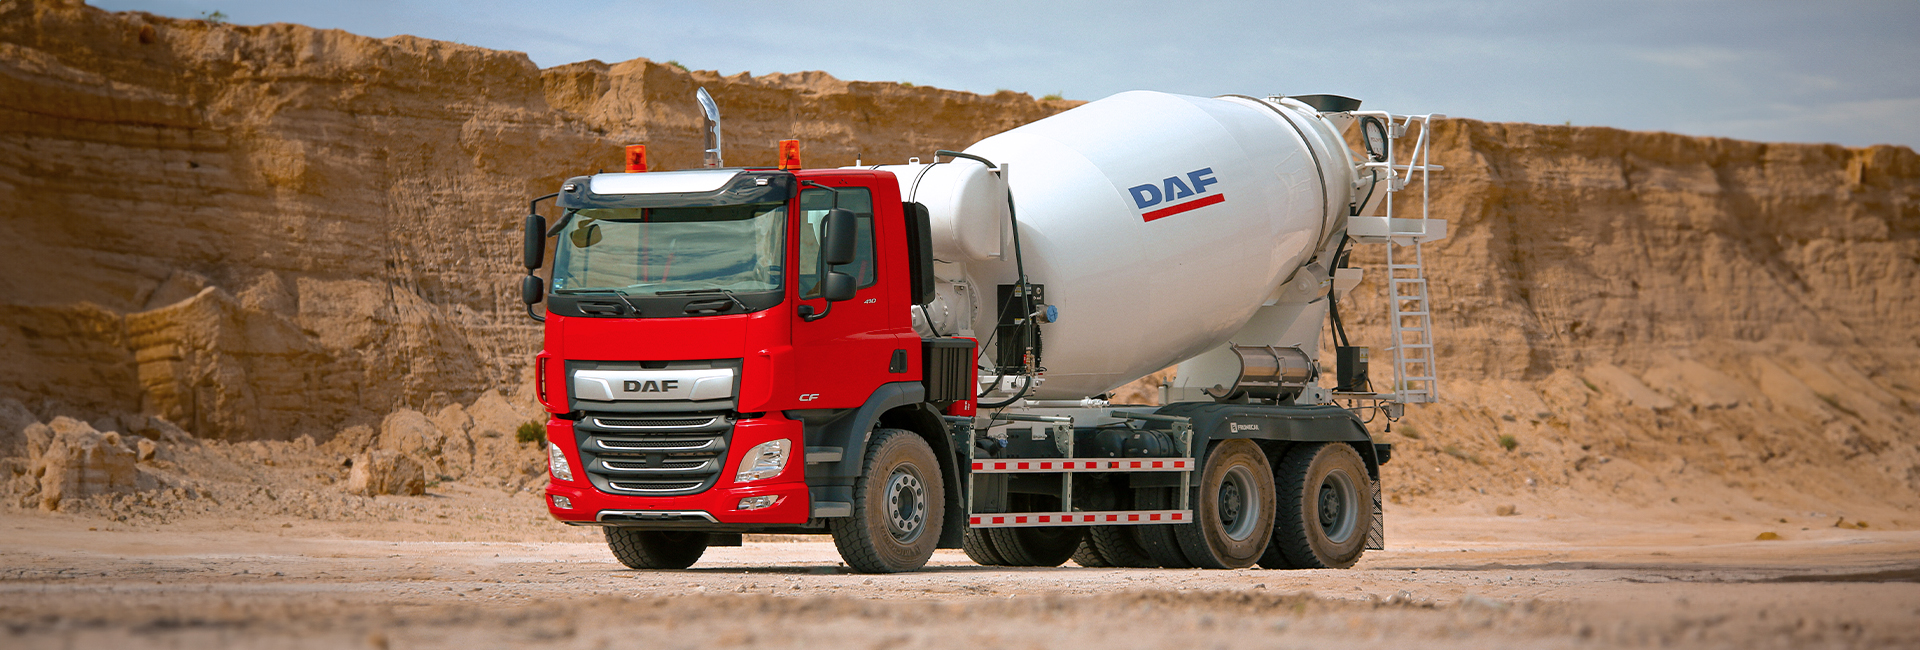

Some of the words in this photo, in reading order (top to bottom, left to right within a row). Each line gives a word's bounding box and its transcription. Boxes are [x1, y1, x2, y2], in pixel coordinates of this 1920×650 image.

[1128, 167, 1218, 210] DAF
[623, 380, 679, 392] DAF
[799, 393, 820, 402] CF
